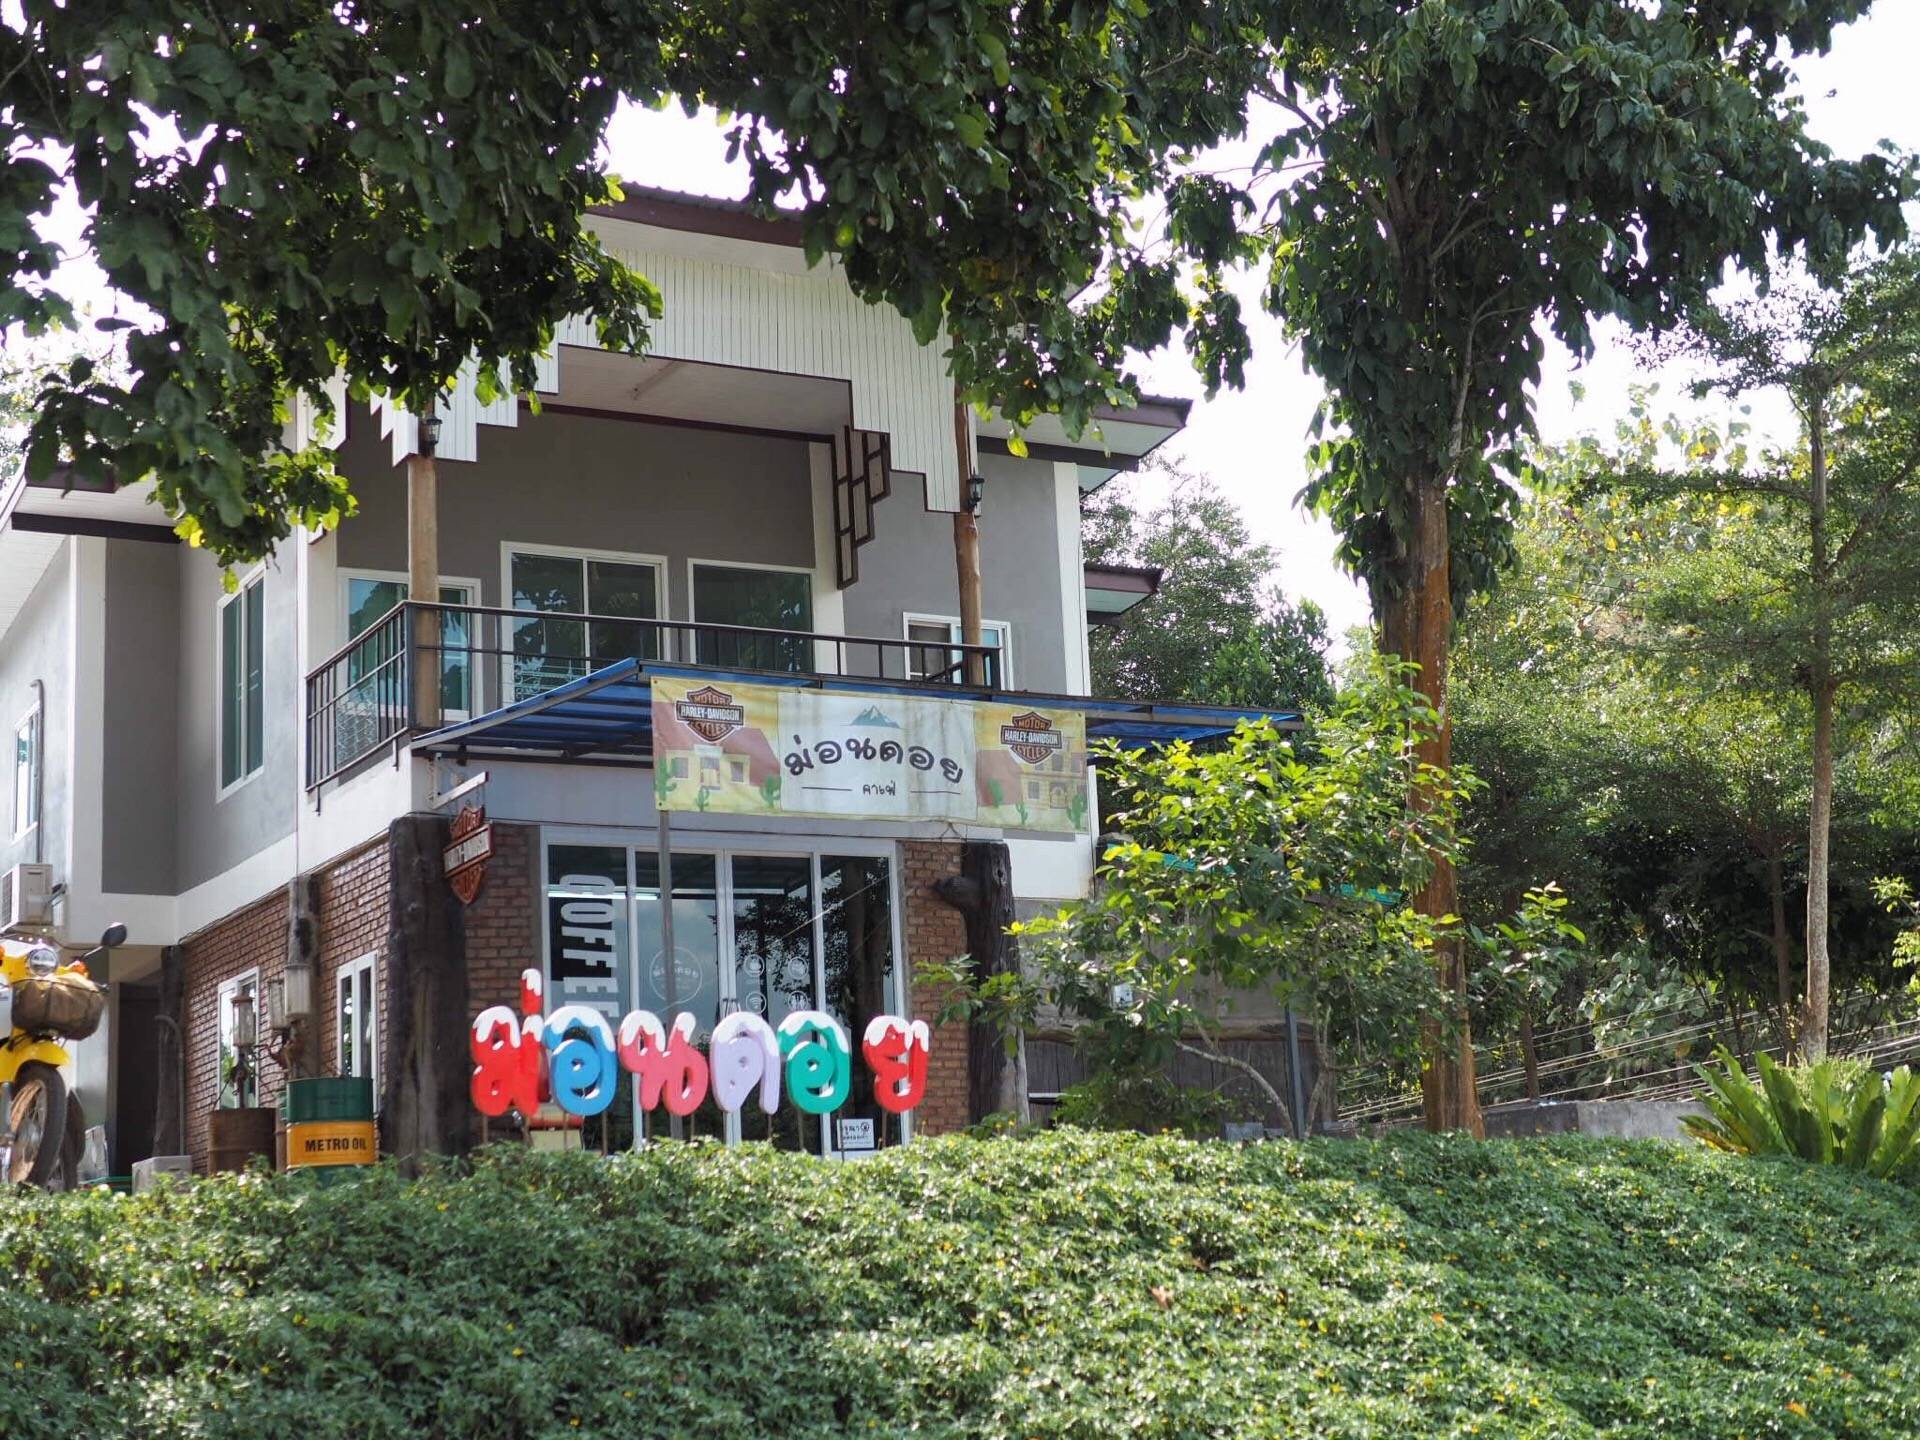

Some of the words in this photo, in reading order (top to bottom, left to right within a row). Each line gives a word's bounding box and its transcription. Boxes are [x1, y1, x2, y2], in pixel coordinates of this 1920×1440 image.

[680, 704, 740, 721] HARLEY-DAVIDSON
[1004, 729, 1058, 745] HARLEY-DAVIDSON
[784, 734, 964, 784] ม่อนดอย
[471, 968, 931, 1117] ม่อนดอย
[305, 1137, 349, 1153] METRO
[352, 1137, 367, 1151] OIL
